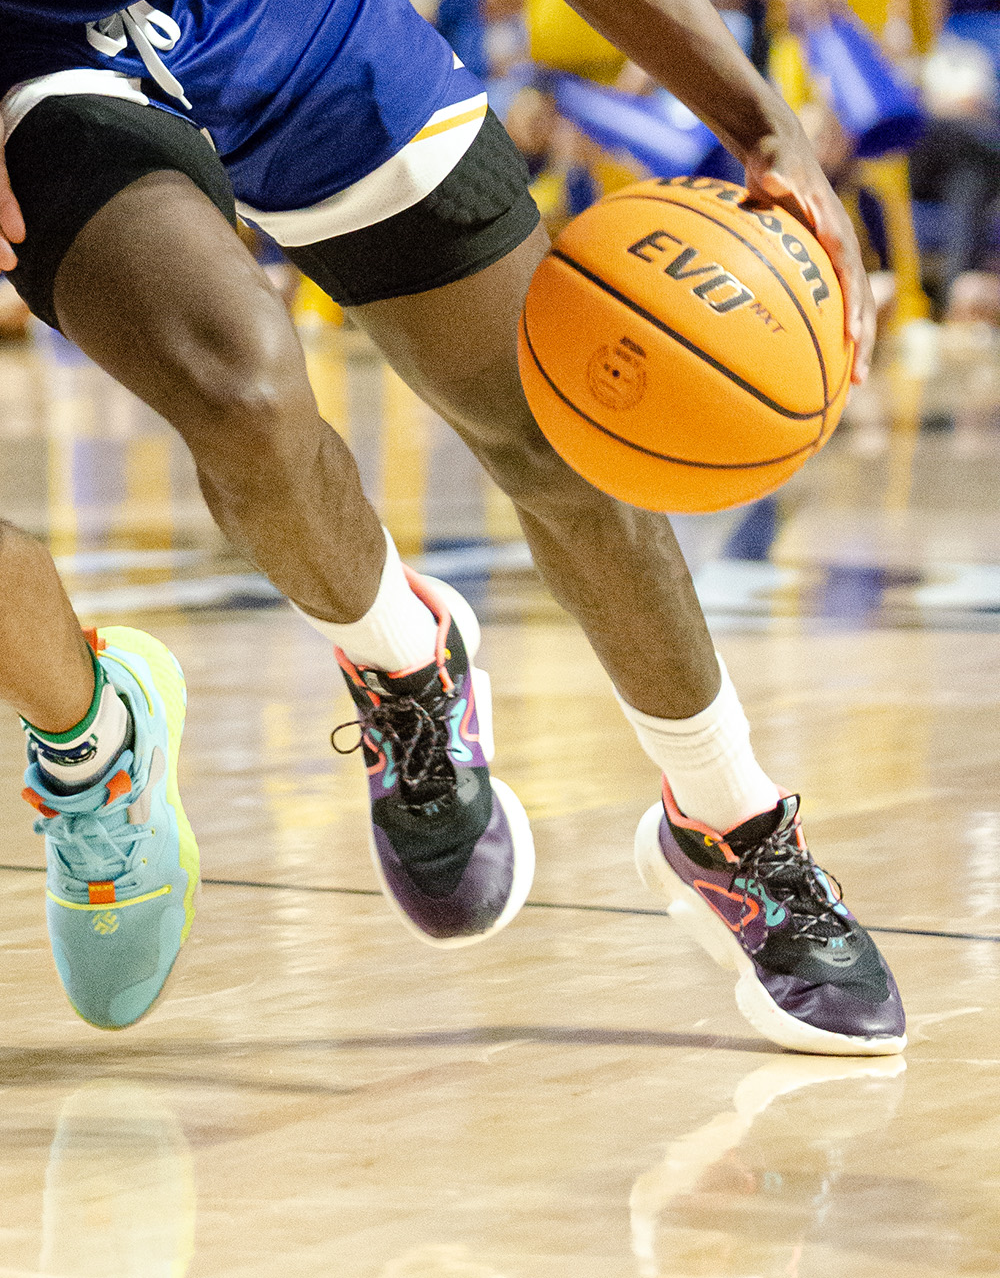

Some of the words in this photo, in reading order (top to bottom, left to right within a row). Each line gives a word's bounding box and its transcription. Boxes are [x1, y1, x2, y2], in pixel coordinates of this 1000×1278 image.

[626, 229, 756, 315] EVO
[656, 176, 831, 307] Wison
[751, 301, 788, 334] NXT
